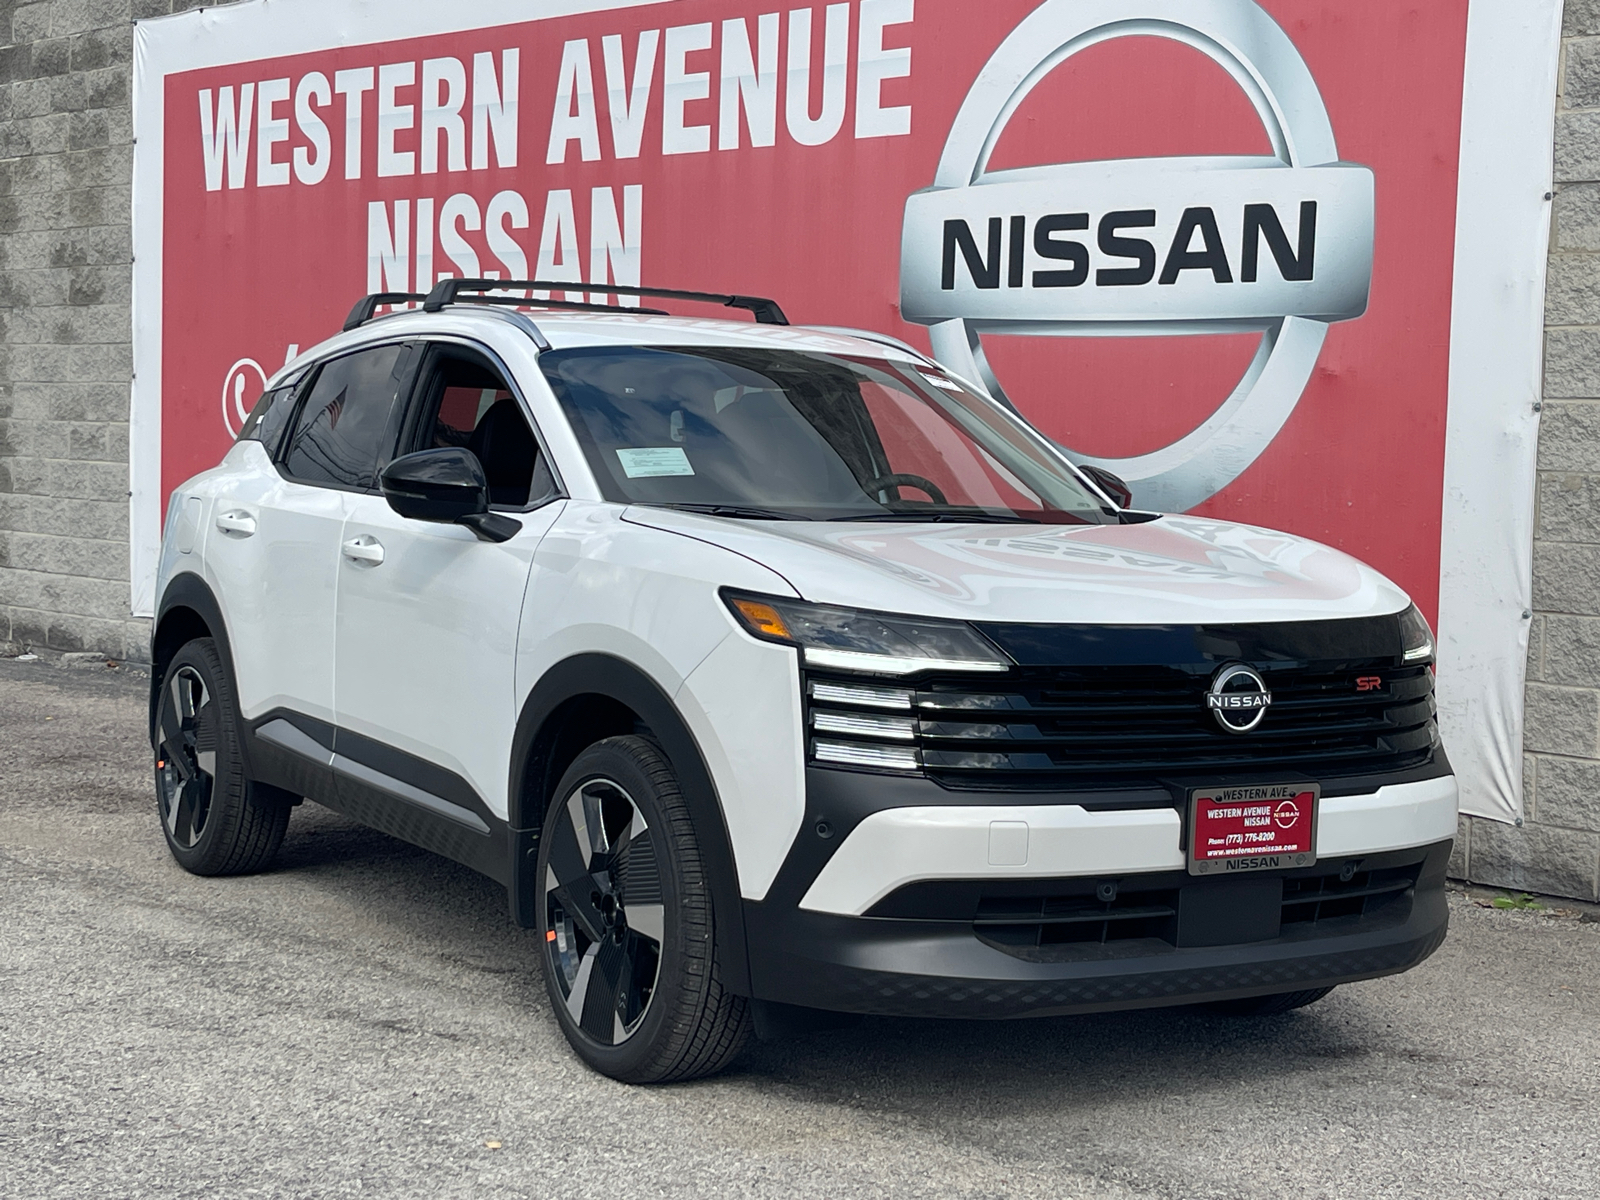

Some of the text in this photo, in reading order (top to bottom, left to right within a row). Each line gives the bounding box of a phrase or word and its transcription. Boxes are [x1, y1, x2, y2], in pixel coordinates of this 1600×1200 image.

[198, 0, 915, 192] WESTERN AVENUE
[367, 184, 643, 311] NISSAN
[940, 200, 1317, 290] NISSAN
[1356, 676, 1382, 691] SR
[1209, 694, 1272, 708] NISSAN
[1223, 788, 1269, 801] WESTERN
[1207, 806, 1271, 820] WESTERN AVENUE
[1244, 816, 1271, 827] NISSAN
[1226, 834, 1243, 846] (773)
[1244, 832, 1275, 842] 776-8200
[1226, 857, 1280, 870] NISSAN
